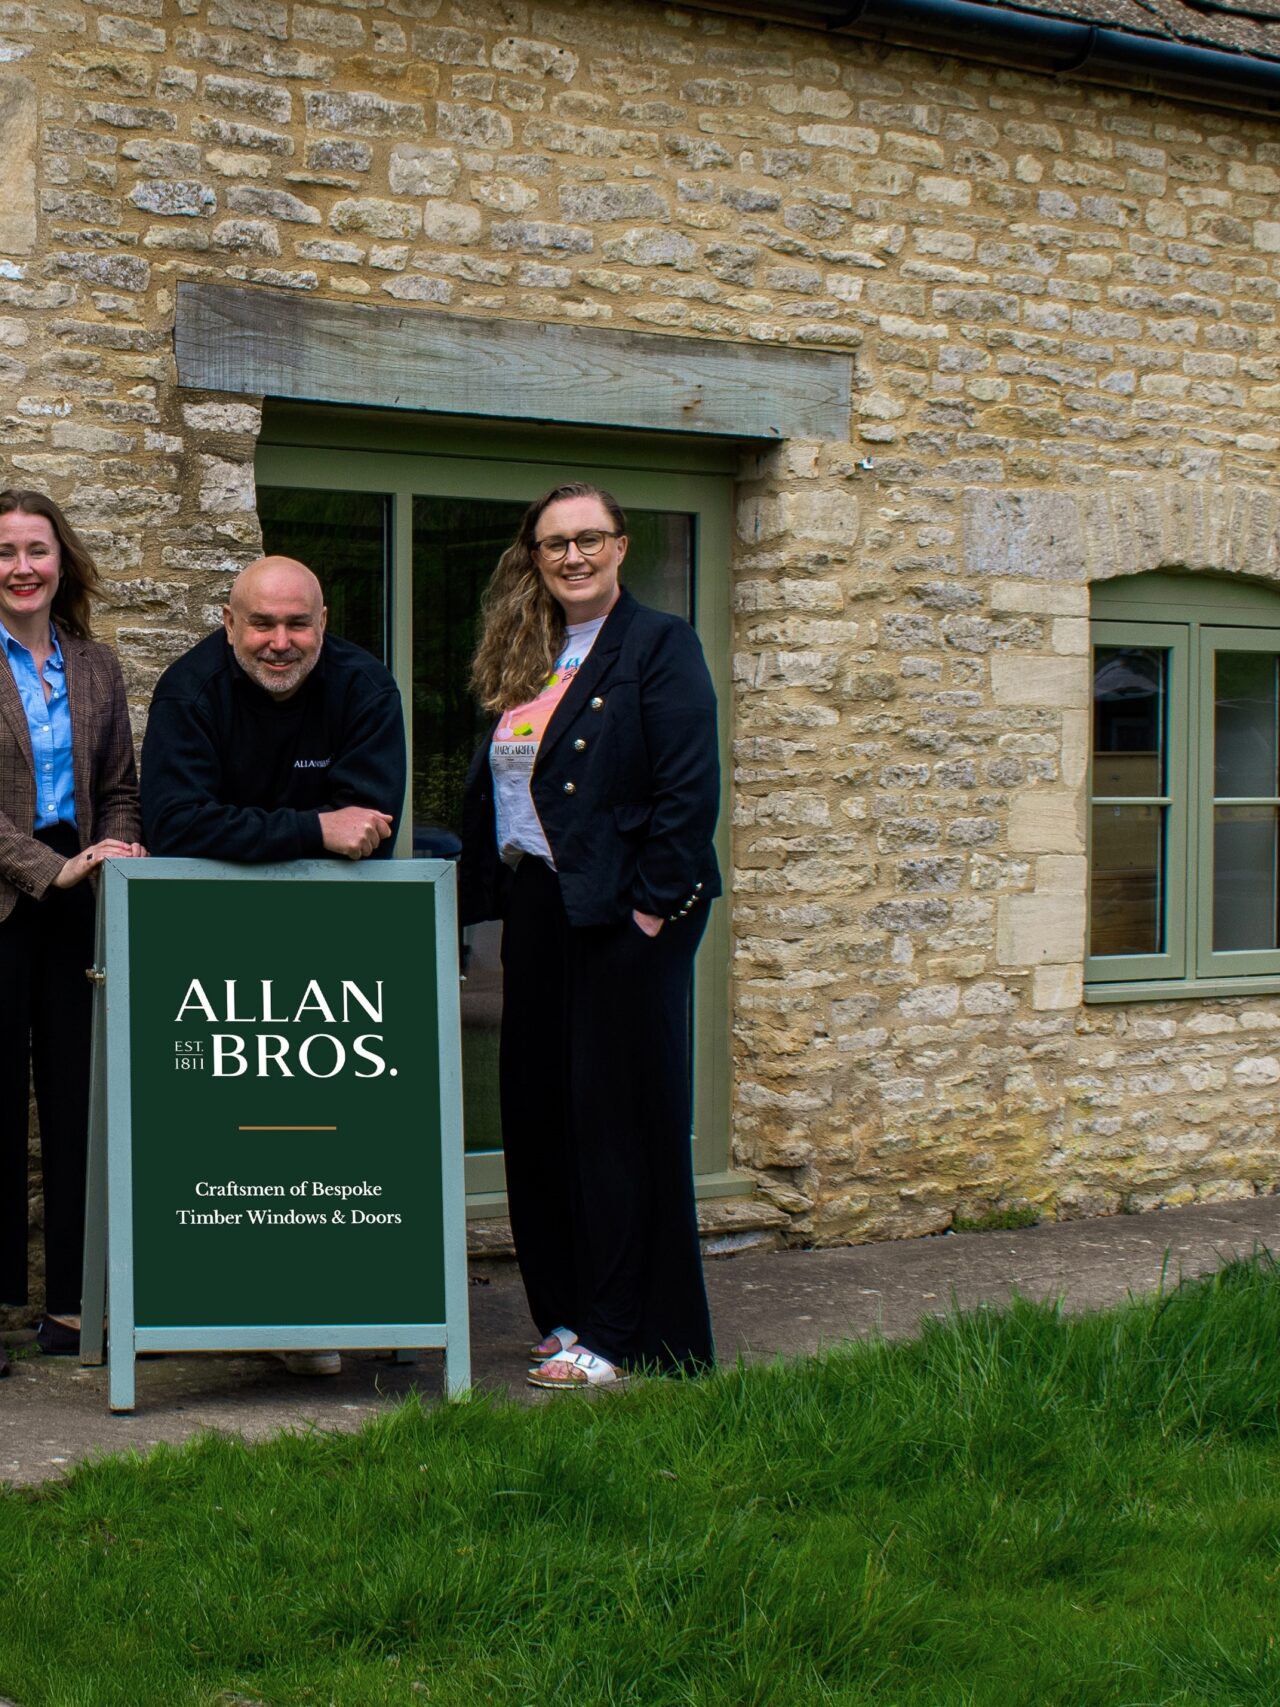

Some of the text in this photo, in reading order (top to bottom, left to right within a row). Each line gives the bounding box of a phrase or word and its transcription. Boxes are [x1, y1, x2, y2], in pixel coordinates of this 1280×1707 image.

[174, 978, 384, 1023] ALLAN
[174, 1040, 204, 1052] EST.
[174, 1057, 205, 1070] 1811
[211, 1033, 398, 1078] BROS.
[195, 1180, 383, 1201] Craftsmen of Bespoke
[175, 1209, 402, 1225] Timber Windows & Doors
